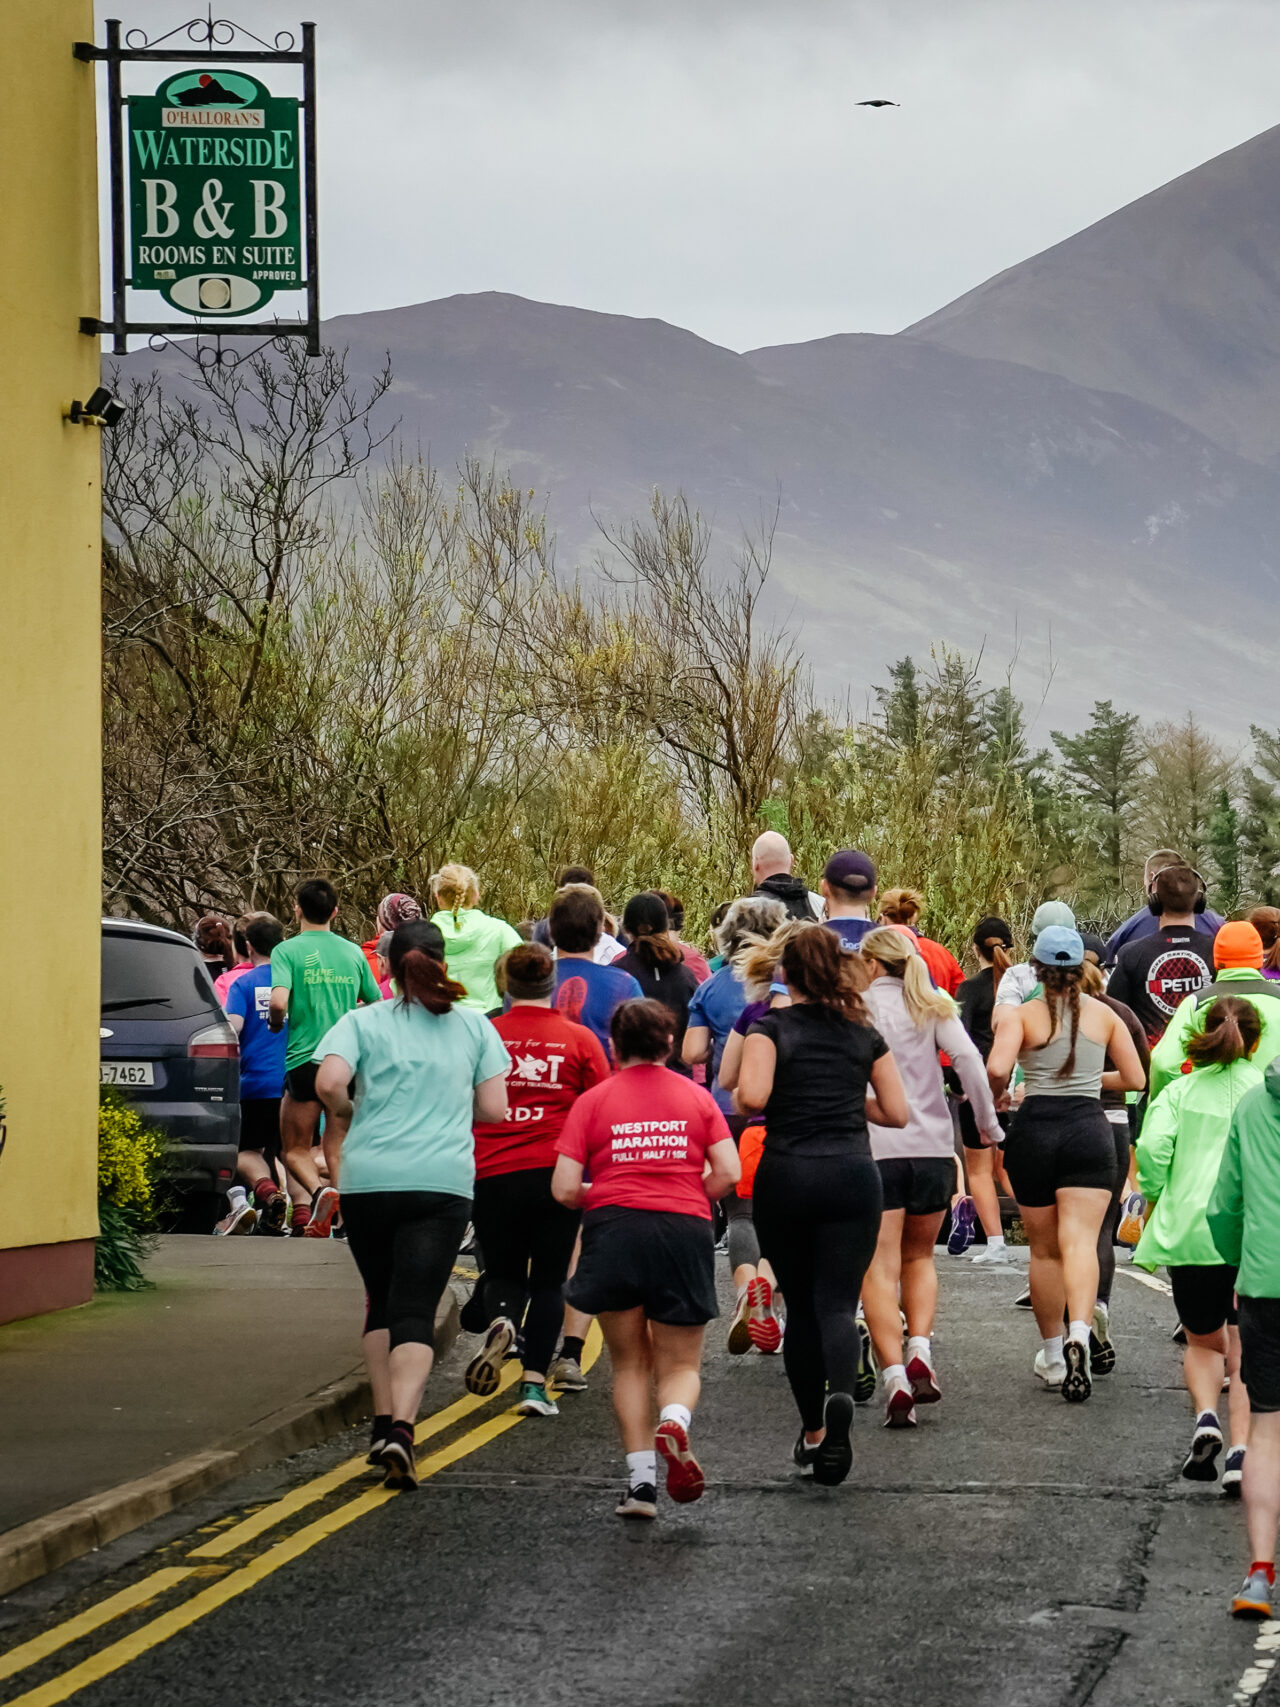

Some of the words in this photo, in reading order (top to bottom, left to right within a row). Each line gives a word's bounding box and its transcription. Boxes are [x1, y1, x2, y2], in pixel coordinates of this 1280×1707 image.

[166, 111, 261, 126] O'HALLORAN'S
[132, 130, 294, 170] WATERSIDE
[141, 178, 180, 238] B
[193, 178, 235, 239] &
[249, 179, 288, 239] B
[139, 245, 206, 265] ROOMS
[212, 246, 236, 265] EN
[242, 246, 295, 265] SUITE
[252, 270, 297, 281] APPROVED
[99, 1067, 146, 1083] -7462
[611, 1121, 688, 1135] WESTPORT
[612, 1135, 688, 1150] MARATHON
